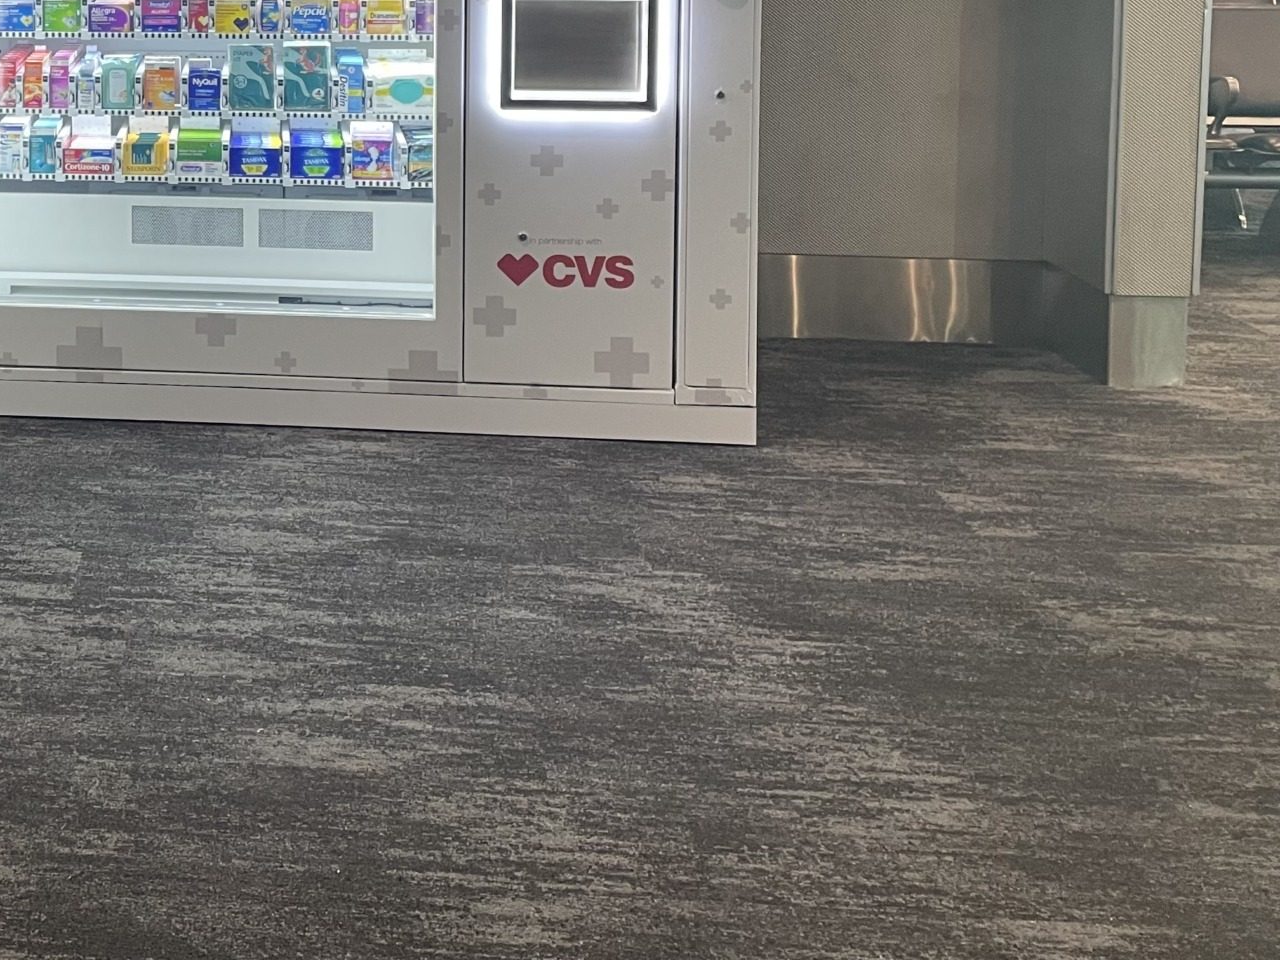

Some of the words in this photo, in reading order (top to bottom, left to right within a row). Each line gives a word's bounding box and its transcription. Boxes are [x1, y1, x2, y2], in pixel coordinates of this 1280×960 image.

[91, 8, 116, 16] Allegra
[293, 7, 326, 17] Pepcid
[192, 78, 218, 87] NyQuil
[340, 76, 348, 107] Desitin
[65, 163, 110, 172] Cortizone-10
[543, 254, 635, 289] CVS
